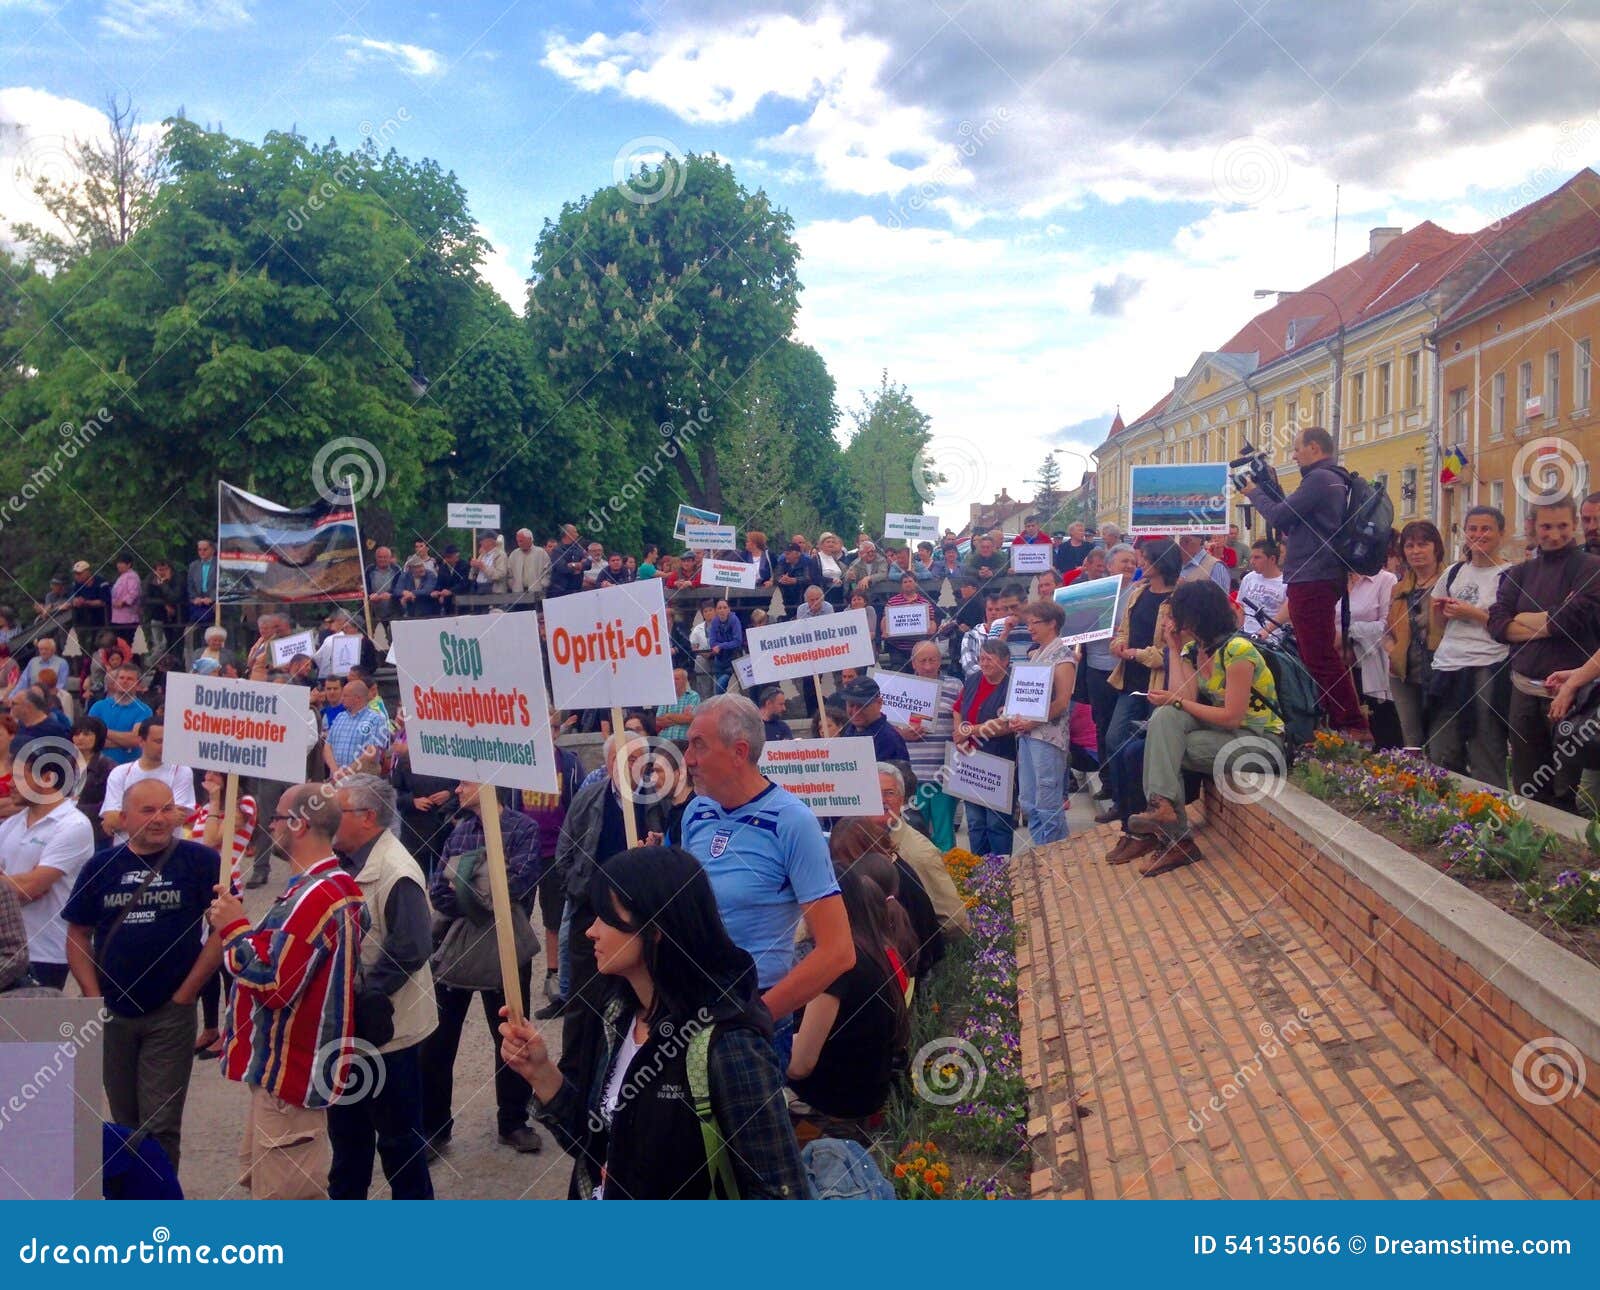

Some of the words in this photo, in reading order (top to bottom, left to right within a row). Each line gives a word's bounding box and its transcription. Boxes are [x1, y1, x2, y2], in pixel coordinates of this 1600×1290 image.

[552, 613, 663, 675] Opriți-o!
[760, 638, 788, 652] Kauft
[788, 632, 813, 647] kein
[814, 627, 837, 641] Holz
[837, 625, 858, 637] von
[439, 631, 483, 680] Stop
[773, 643, 850, 666] Schweighofer!
[195, 684, 278, 714] Boykottiert
[413, 685, 531, 728] Schweighofer's
[183, 709, 287, 742] Schweighofer
[198, 740, 267, 767] weltweit!
[420, 731, 537, 766] forest-slaughterhouse!
[767, 749, 829, 761] Schweighofer
[758, 763, 803, 774] estroying
[804, 764, 820, 773] our
[821, 761, 858, 773] forests!
[782, 782, 835, 794] hweighofer
[812, 797, 827, 806] our
[829, 795, 860, 806] future!
[103, 890, 181, 908] MARTHON
[126, 910, 157, 919] ESWICK
